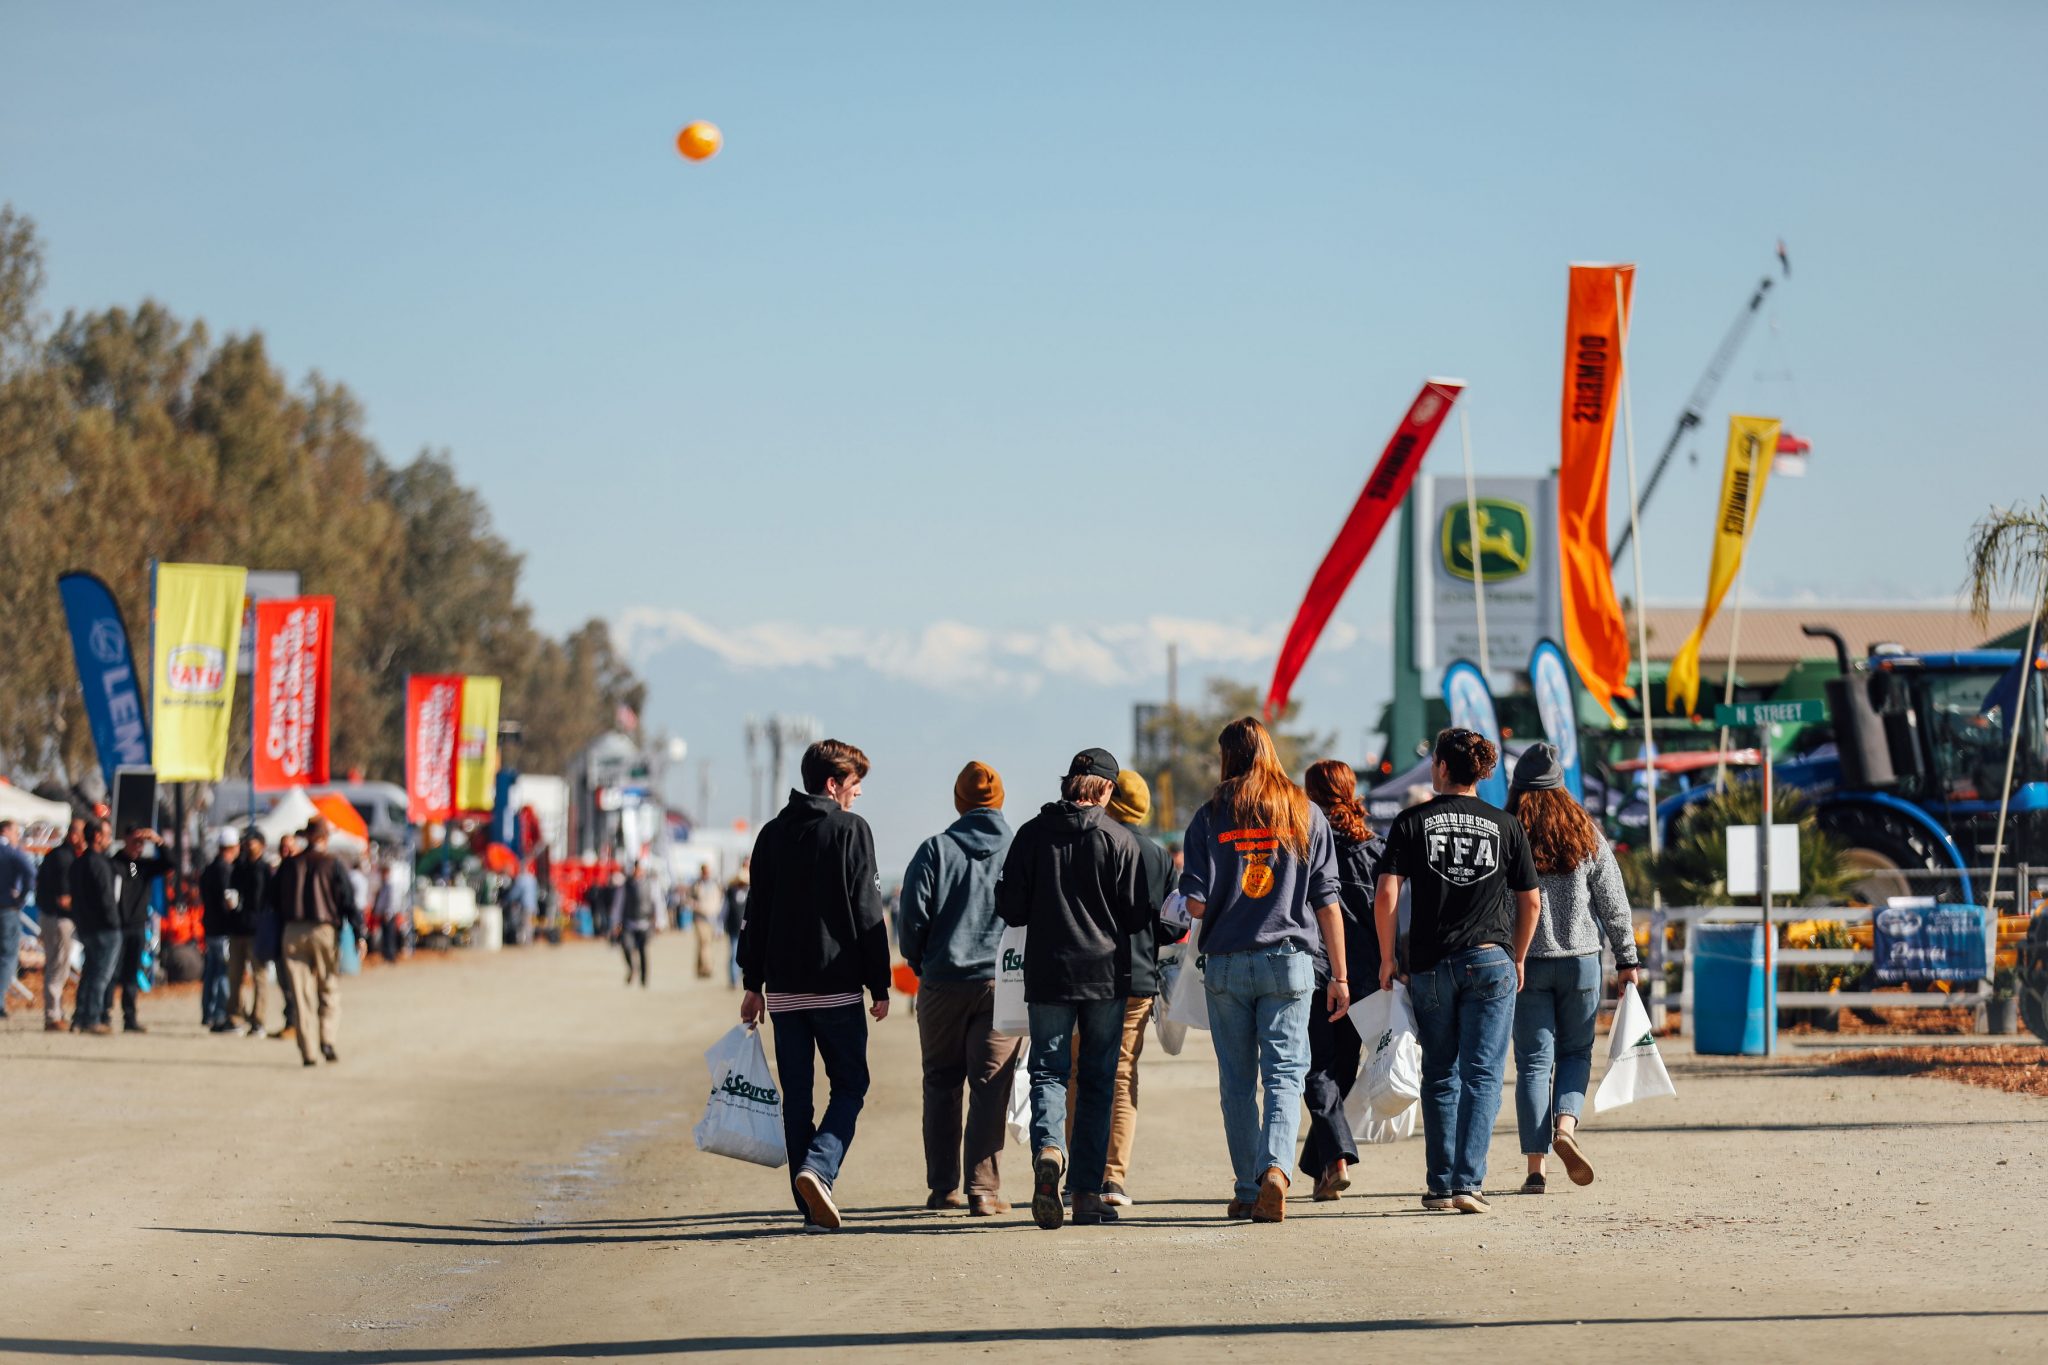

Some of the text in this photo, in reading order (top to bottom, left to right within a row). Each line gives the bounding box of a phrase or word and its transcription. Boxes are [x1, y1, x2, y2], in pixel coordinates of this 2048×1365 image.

[1736, 703, 1802, 724] N STREET
[1459, 813, 1474, 827] HIGH
[1475, 816, 1500, 834] SCHOOL
[1429, 834, 1496, 867] FFA
